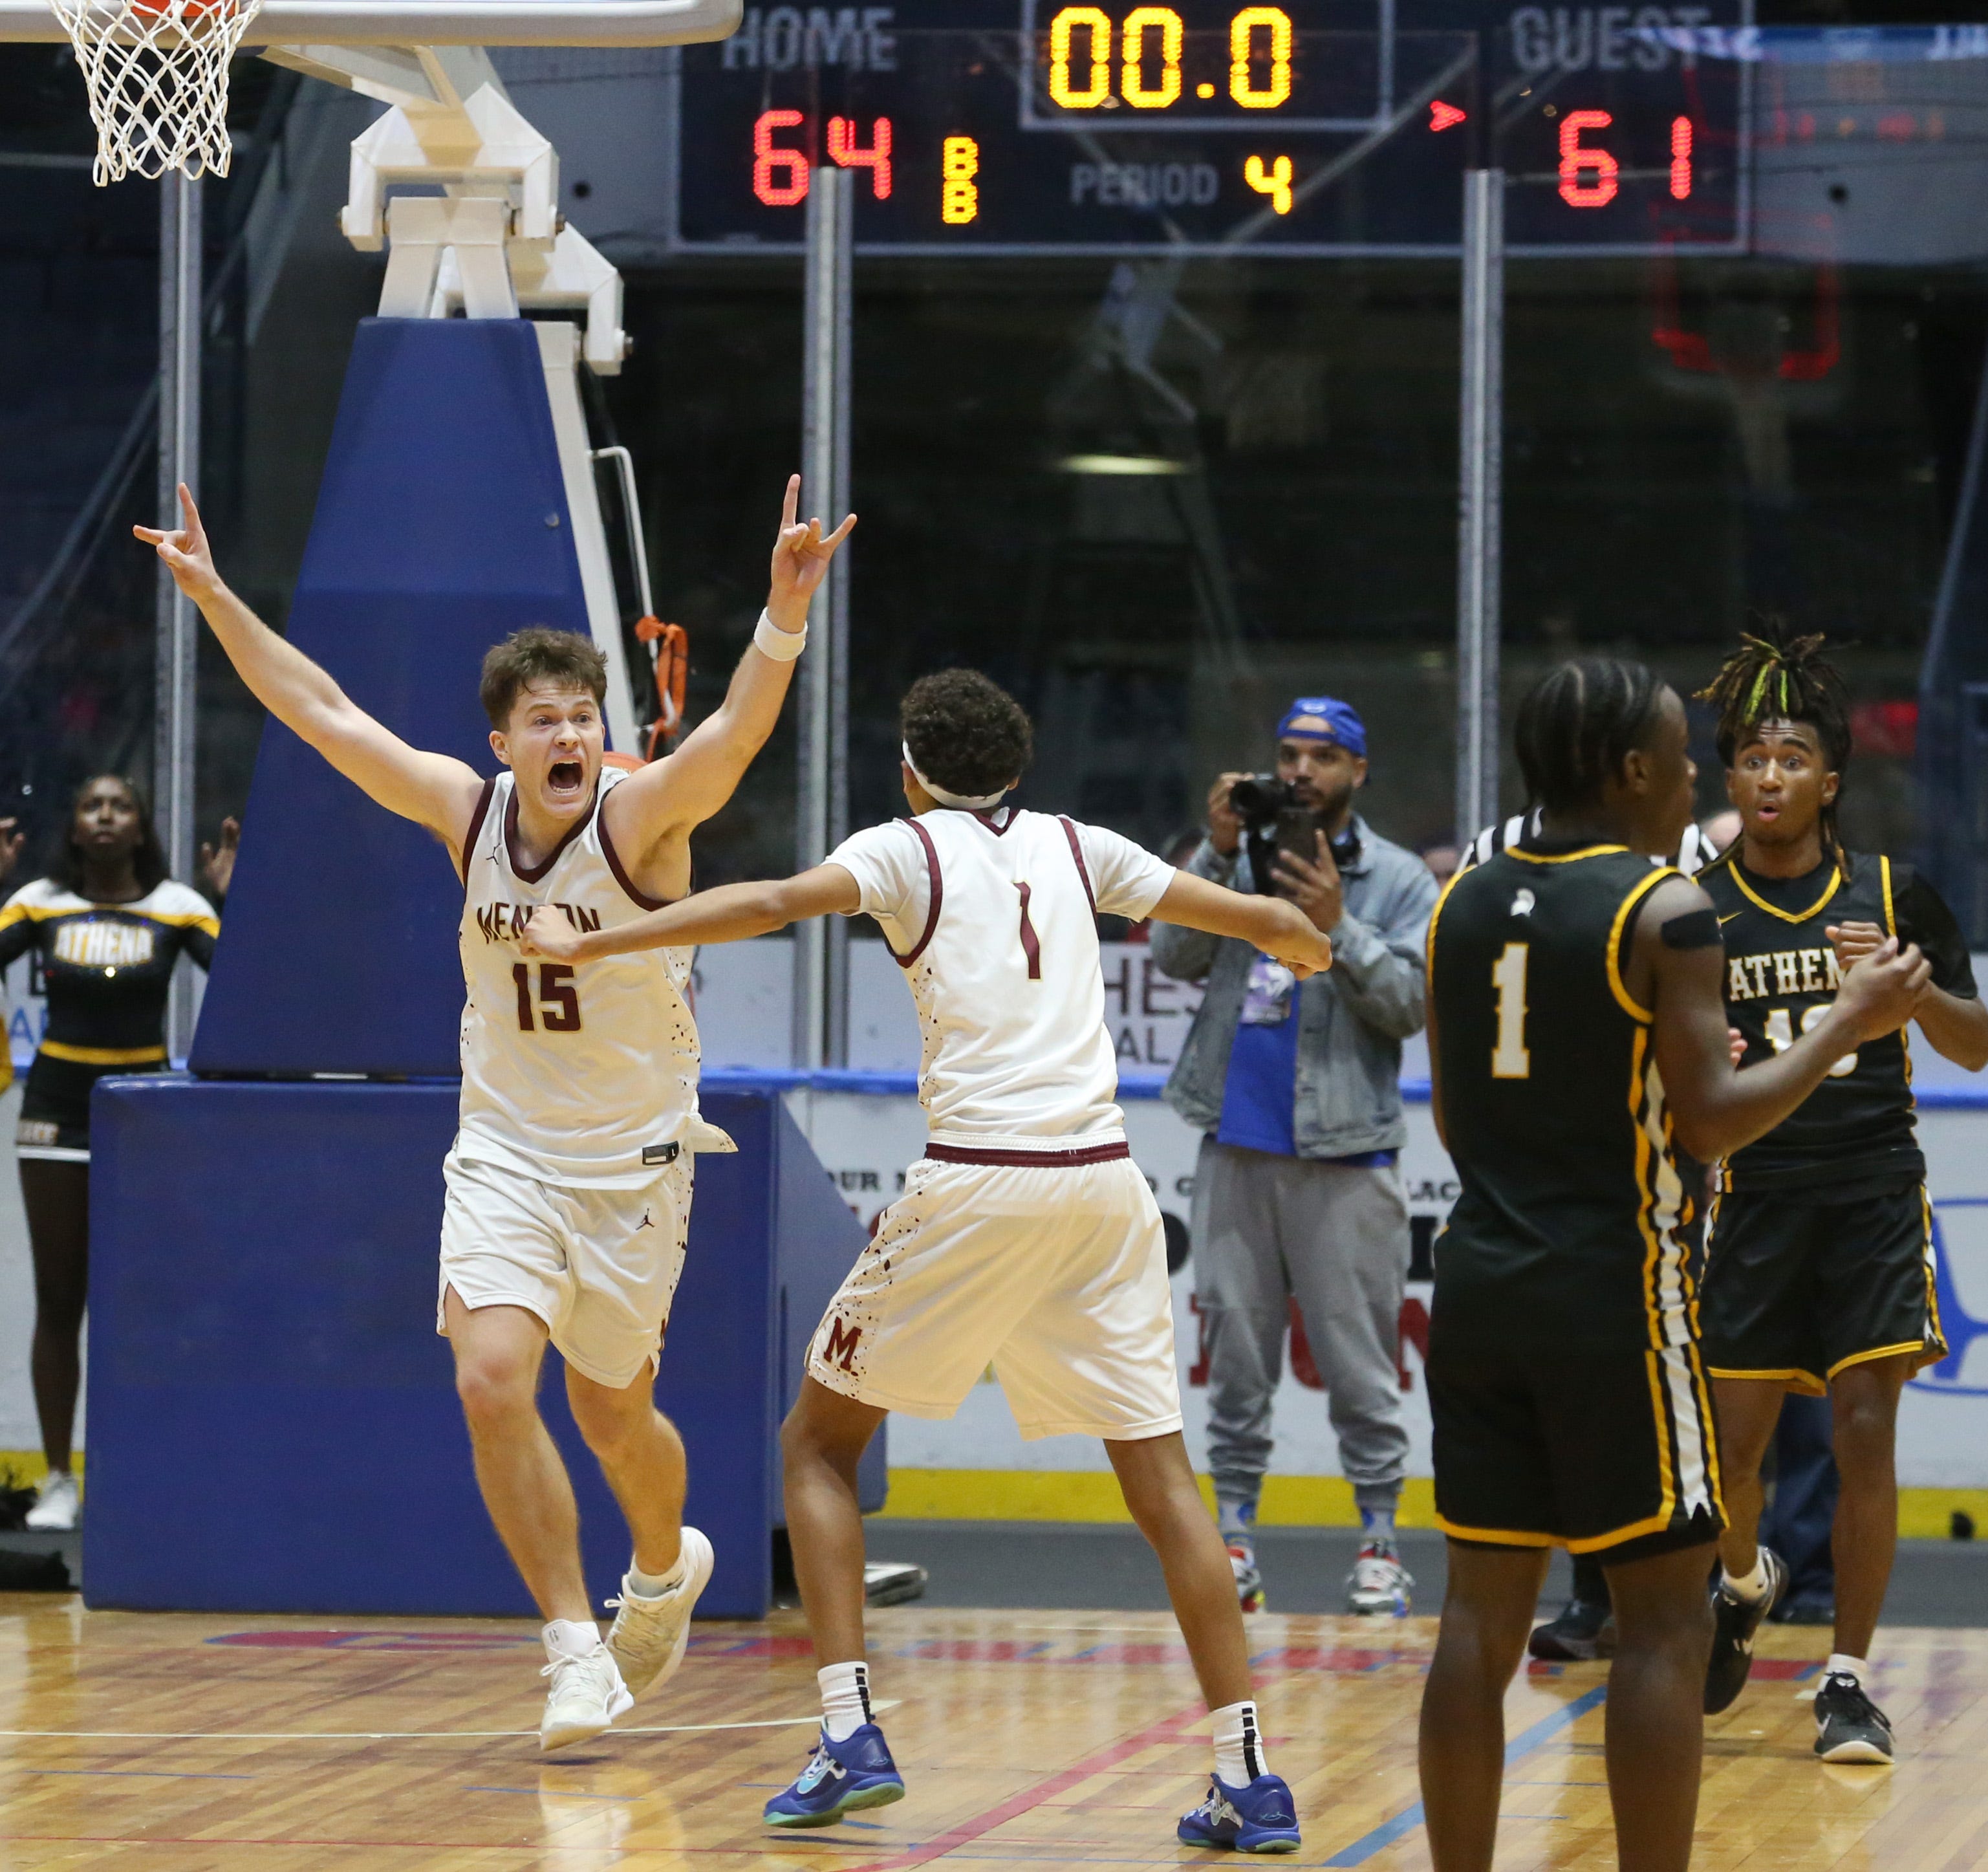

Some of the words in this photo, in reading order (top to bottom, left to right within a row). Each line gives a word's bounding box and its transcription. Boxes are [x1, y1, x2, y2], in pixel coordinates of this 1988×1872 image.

[722, 6, 898, 71] HOME
[1049, 7, 1292, 109] 00.0
[1510, 6, 1712, 71] GUEST
[1070, 164, 1220, 206] PERIOD
[1244, 155, 1293, 215] 4
[1559, 111, 1692, 207] 61
[54, 921, 154, 968] ATHENA
[477, 902, 601, 944] MENN
[1013, 880, 1044, 981] 1
[512, 963, 581, 1032] 15
[1492, 941, 1530, 1079] 1
[823, 1315, 863, 1372] M
